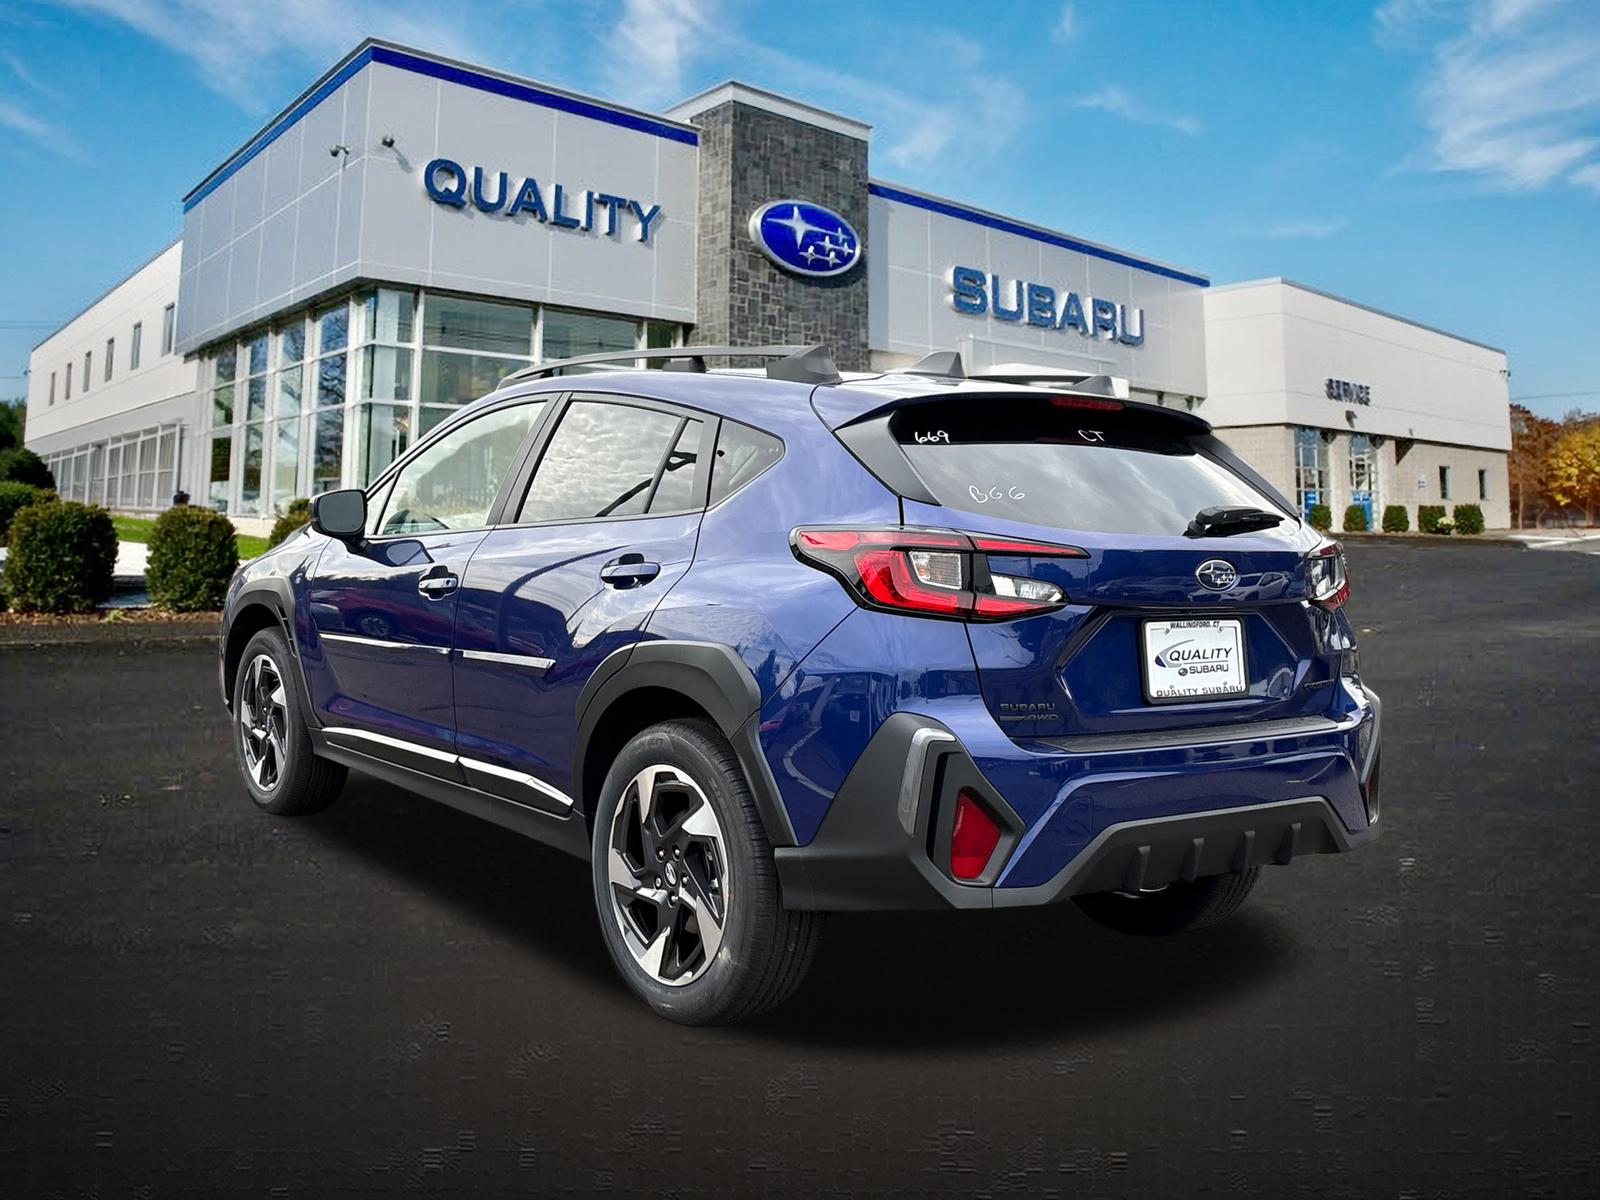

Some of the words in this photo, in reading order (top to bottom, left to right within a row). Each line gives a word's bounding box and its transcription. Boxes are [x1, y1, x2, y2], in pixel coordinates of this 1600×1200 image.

[423, 158, 662, 242] QUALITY
[951, 265, 1145, 347] SUBARU
[914, 429, 950, 444] 669
[1078, 429, 1105, 442] CT
[1213, 620, 1219, 628] CT
[1169, 647, 1233, 662] QUALITY
[1189, 664, 1229, 674] SUBARU
[1156, 688, 1199, 697] QUALITY
[1202, 685, 1243, 695] SUBARU
[1000, 702, 1056, 711] SUBARU
